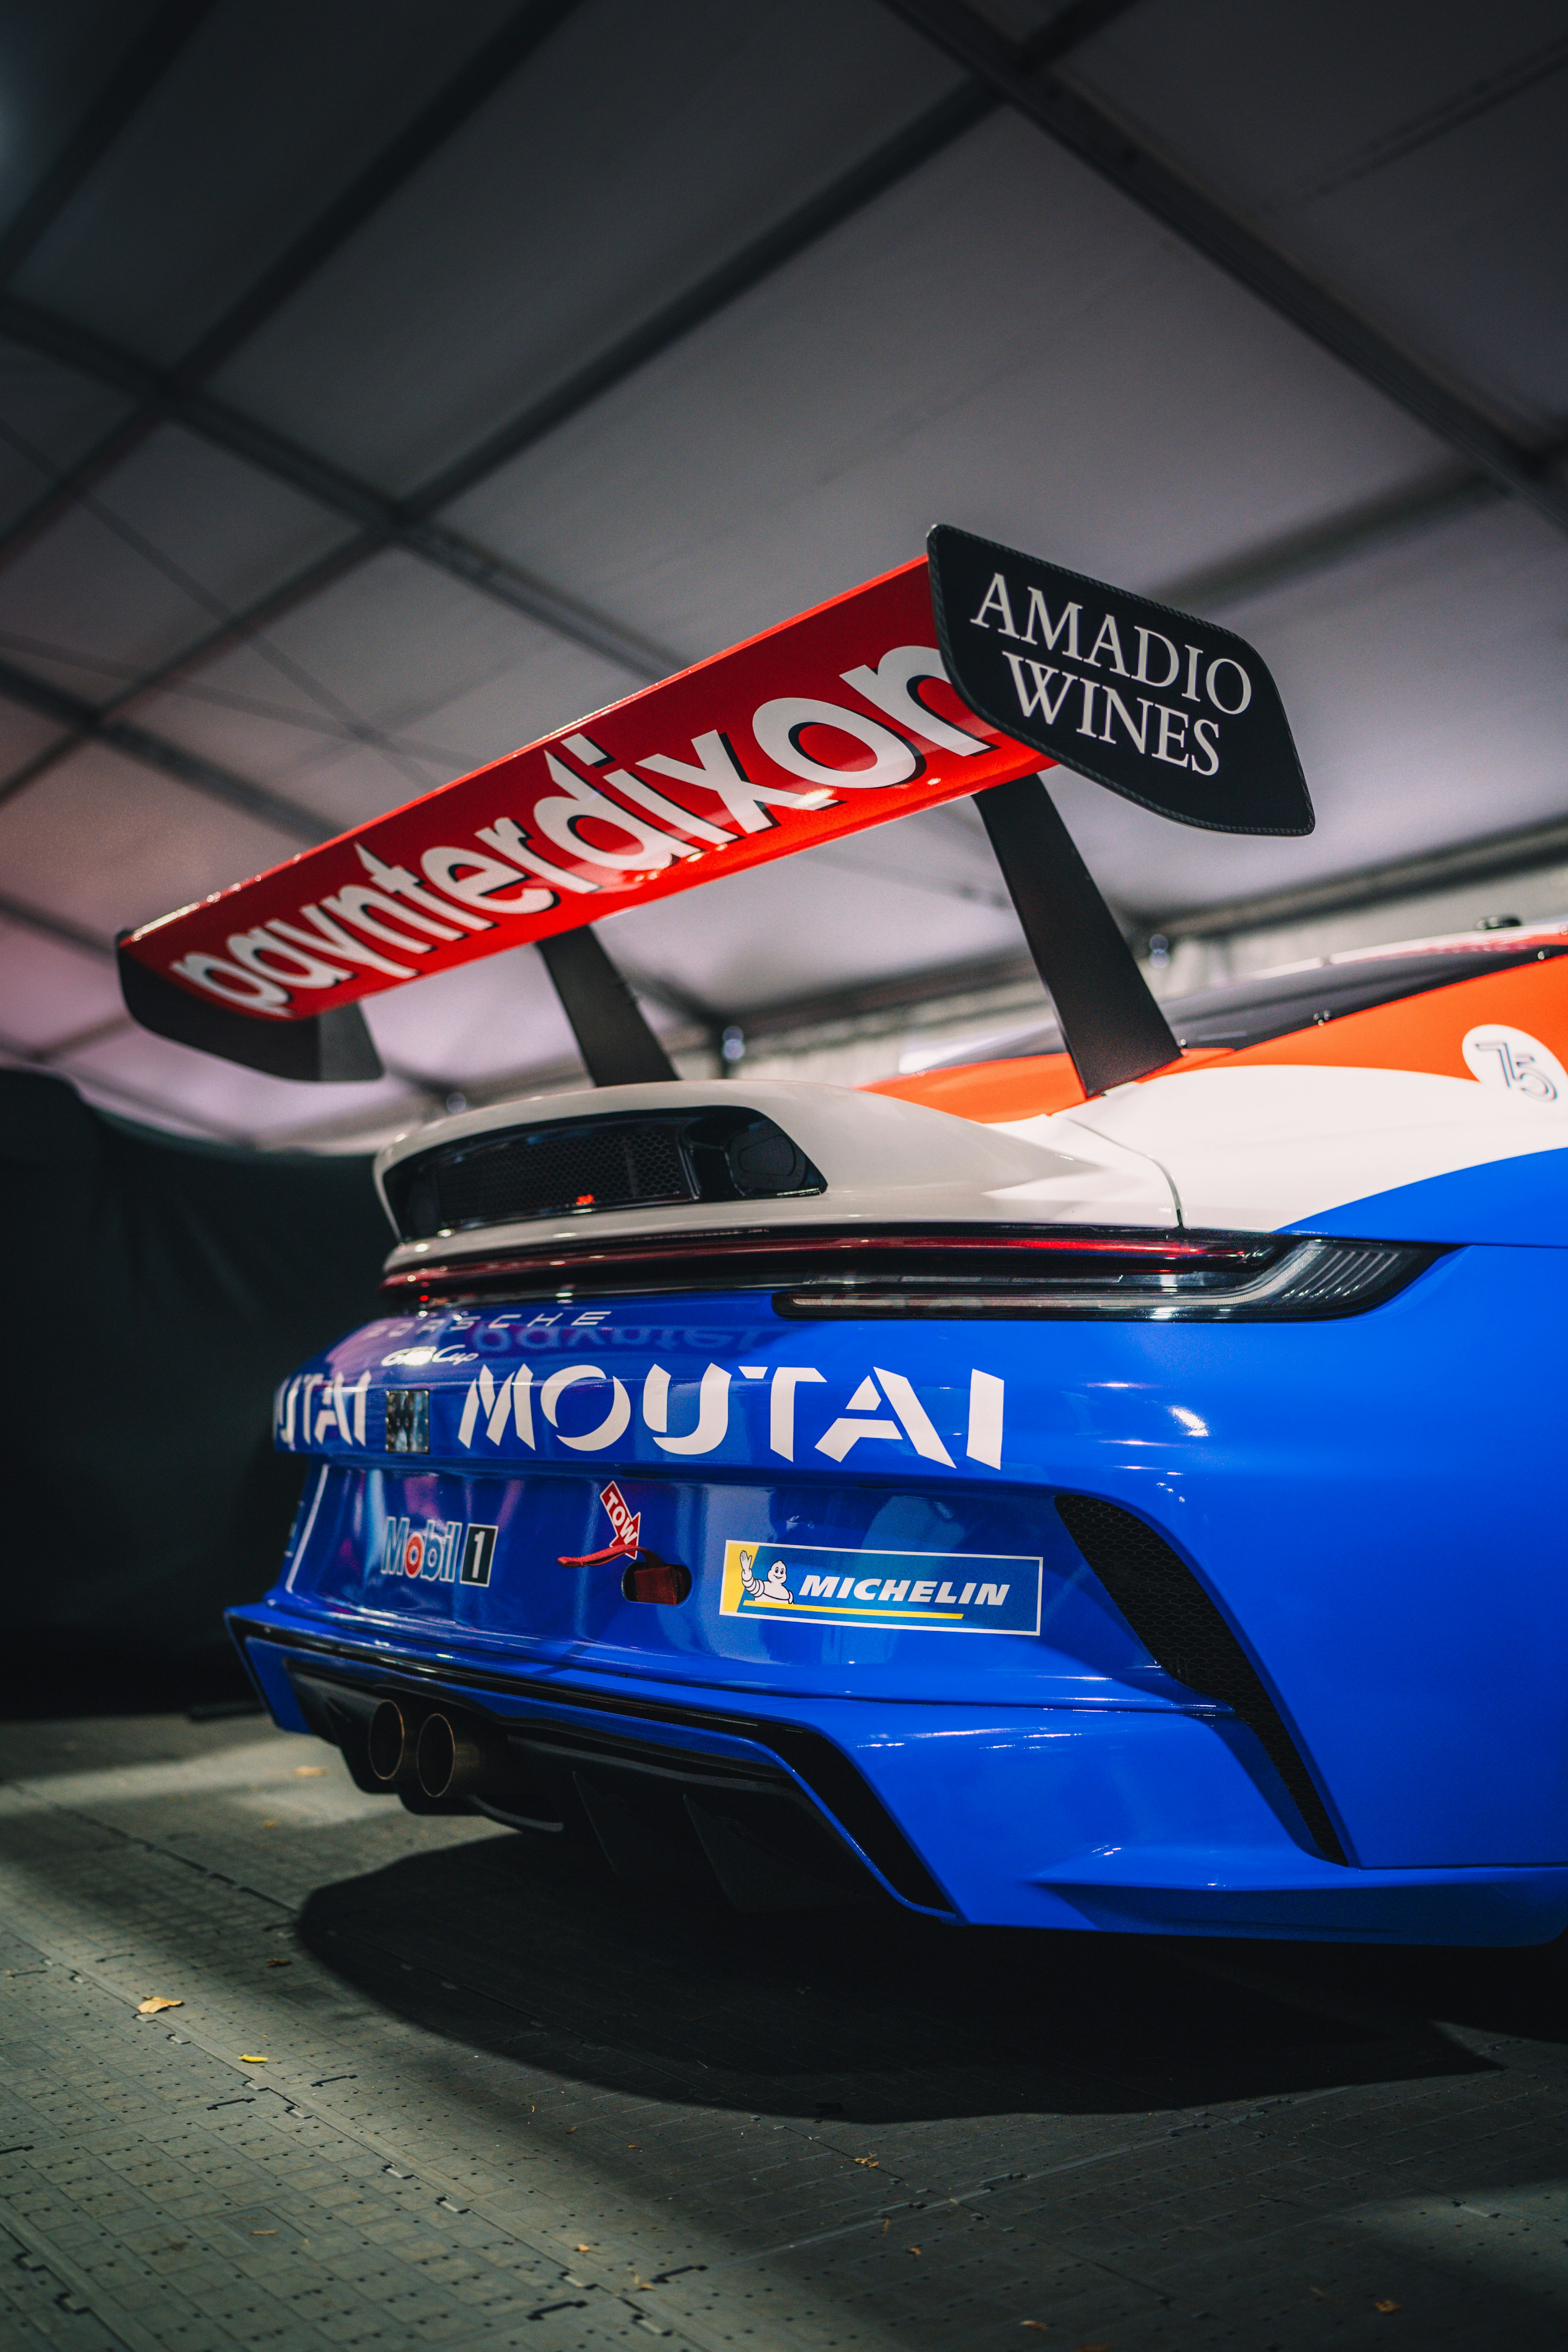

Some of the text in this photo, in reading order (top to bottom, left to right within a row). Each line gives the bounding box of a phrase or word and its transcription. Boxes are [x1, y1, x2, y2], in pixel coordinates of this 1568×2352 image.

[970, 572, 1252, 715] AMADIO
[1002, 650, 1220, 776] WINES
[1474, 1040, 1557, 1103] 75
[432, 1344, 479, 1366] Cup
[458, 1362, 1004, 1470] MOUTAI
[380, 1516, 463, 1583] Mobil
[607, 1491, 638, 1545] TOW
[799, 1574, 1010, 1605] MICHELIN
